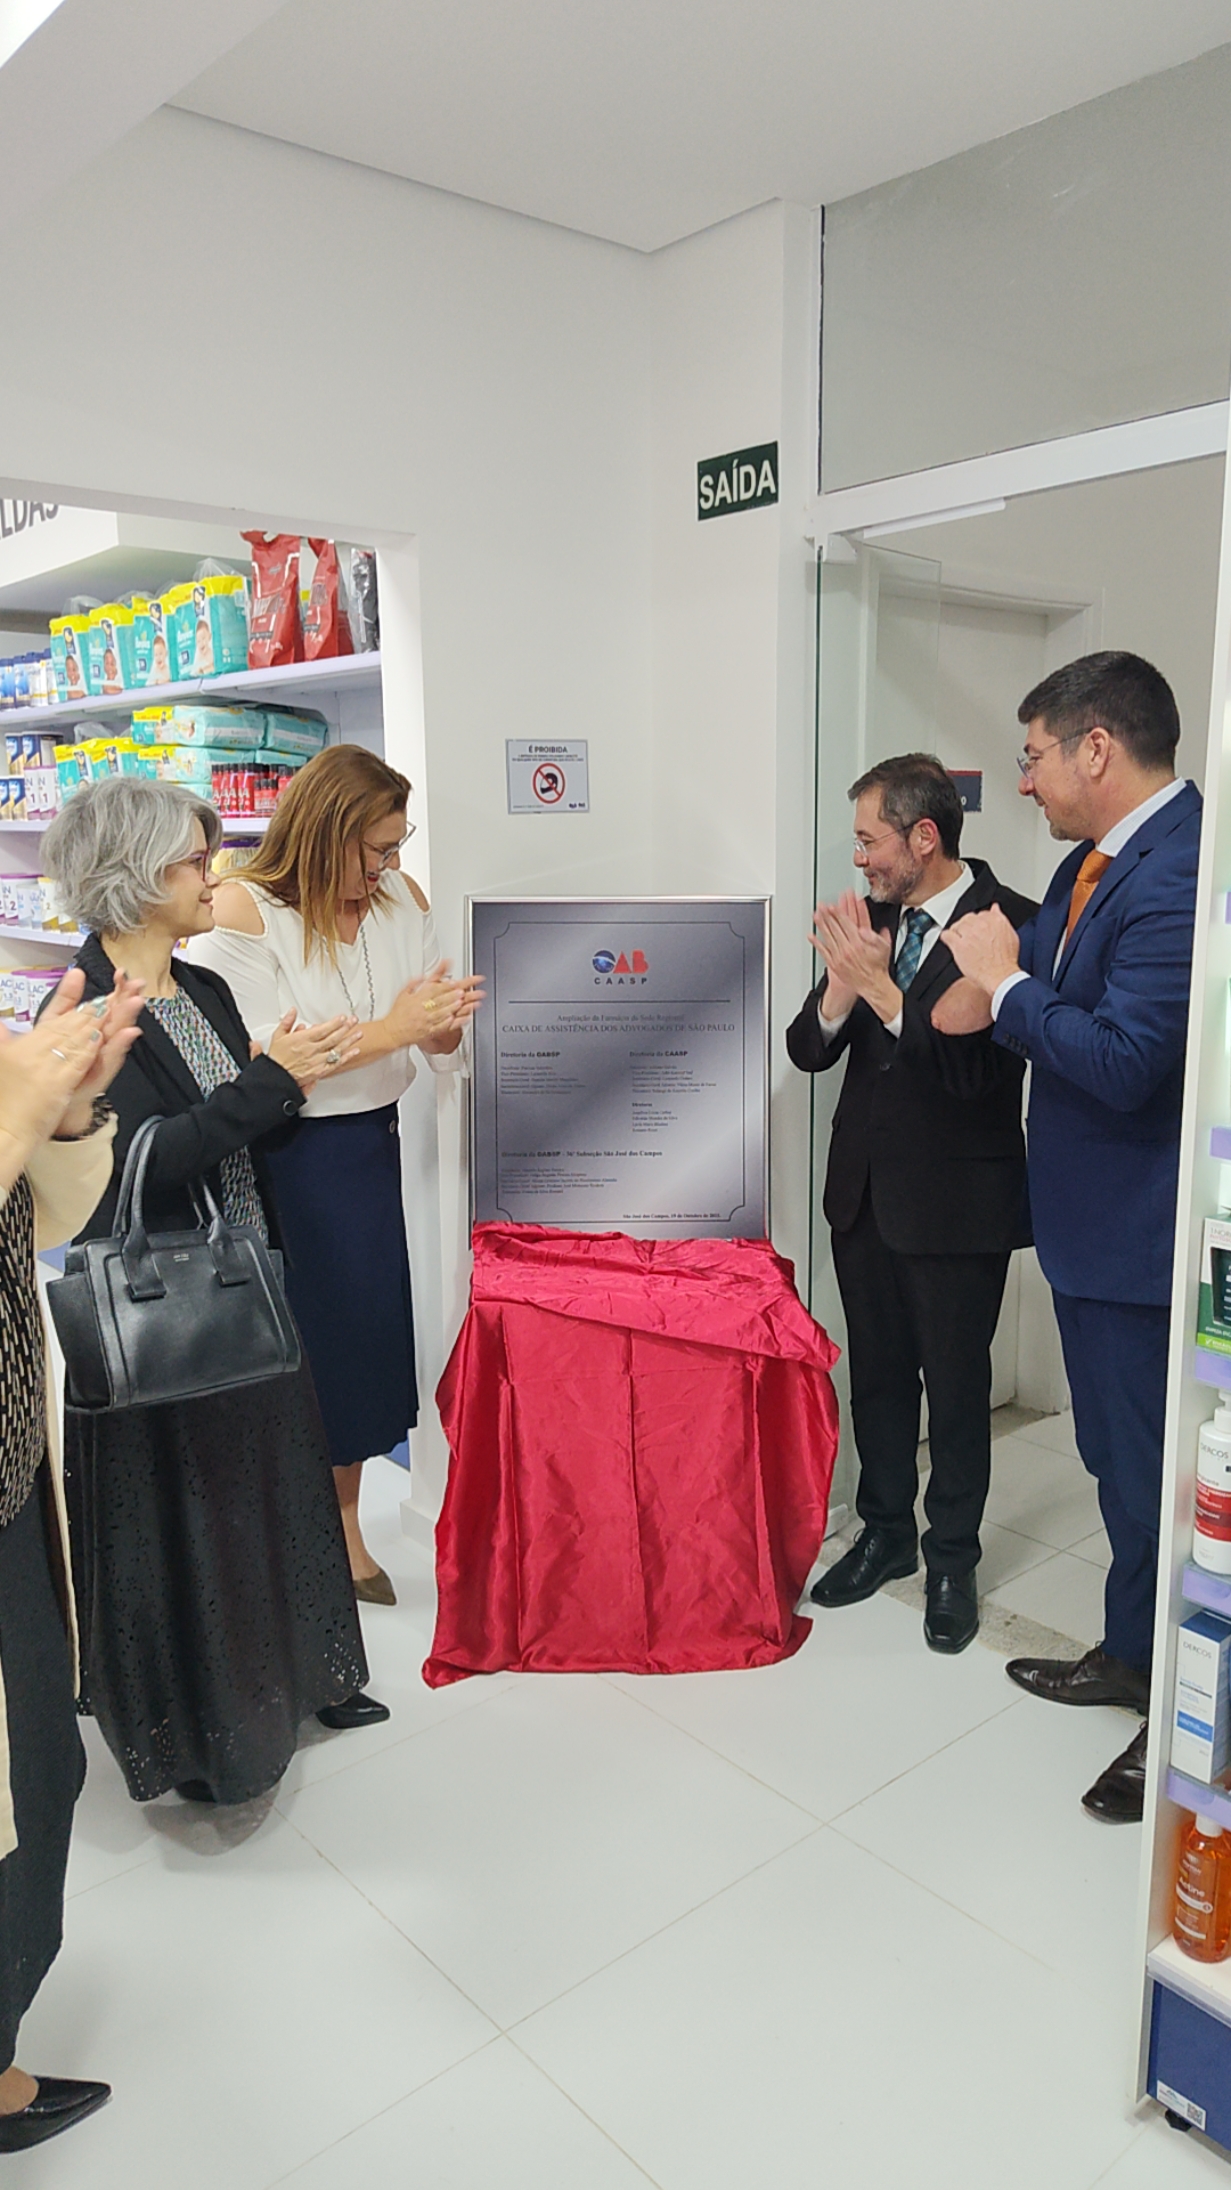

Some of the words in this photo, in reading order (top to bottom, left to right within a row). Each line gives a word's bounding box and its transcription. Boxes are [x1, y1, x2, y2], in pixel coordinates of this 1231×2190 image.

[700, 459, 776, 510] SAÍDA
[528, 745, 533, 753] É
[594, 977, 647, 985] CAASP
[502, 1025, 529, 1033] CAIXA
[531, 1025, 543, 1033] DE
[545, 1023, 599, 1033] ASSISTÊNCIA
[619, 1024, 673, 1032] ADVOGADOS
[675, 1024, 684, 1032] DE
[688, 1022, 705, 1031] SÃO
[639, 1150, 662, 1158] Campos
